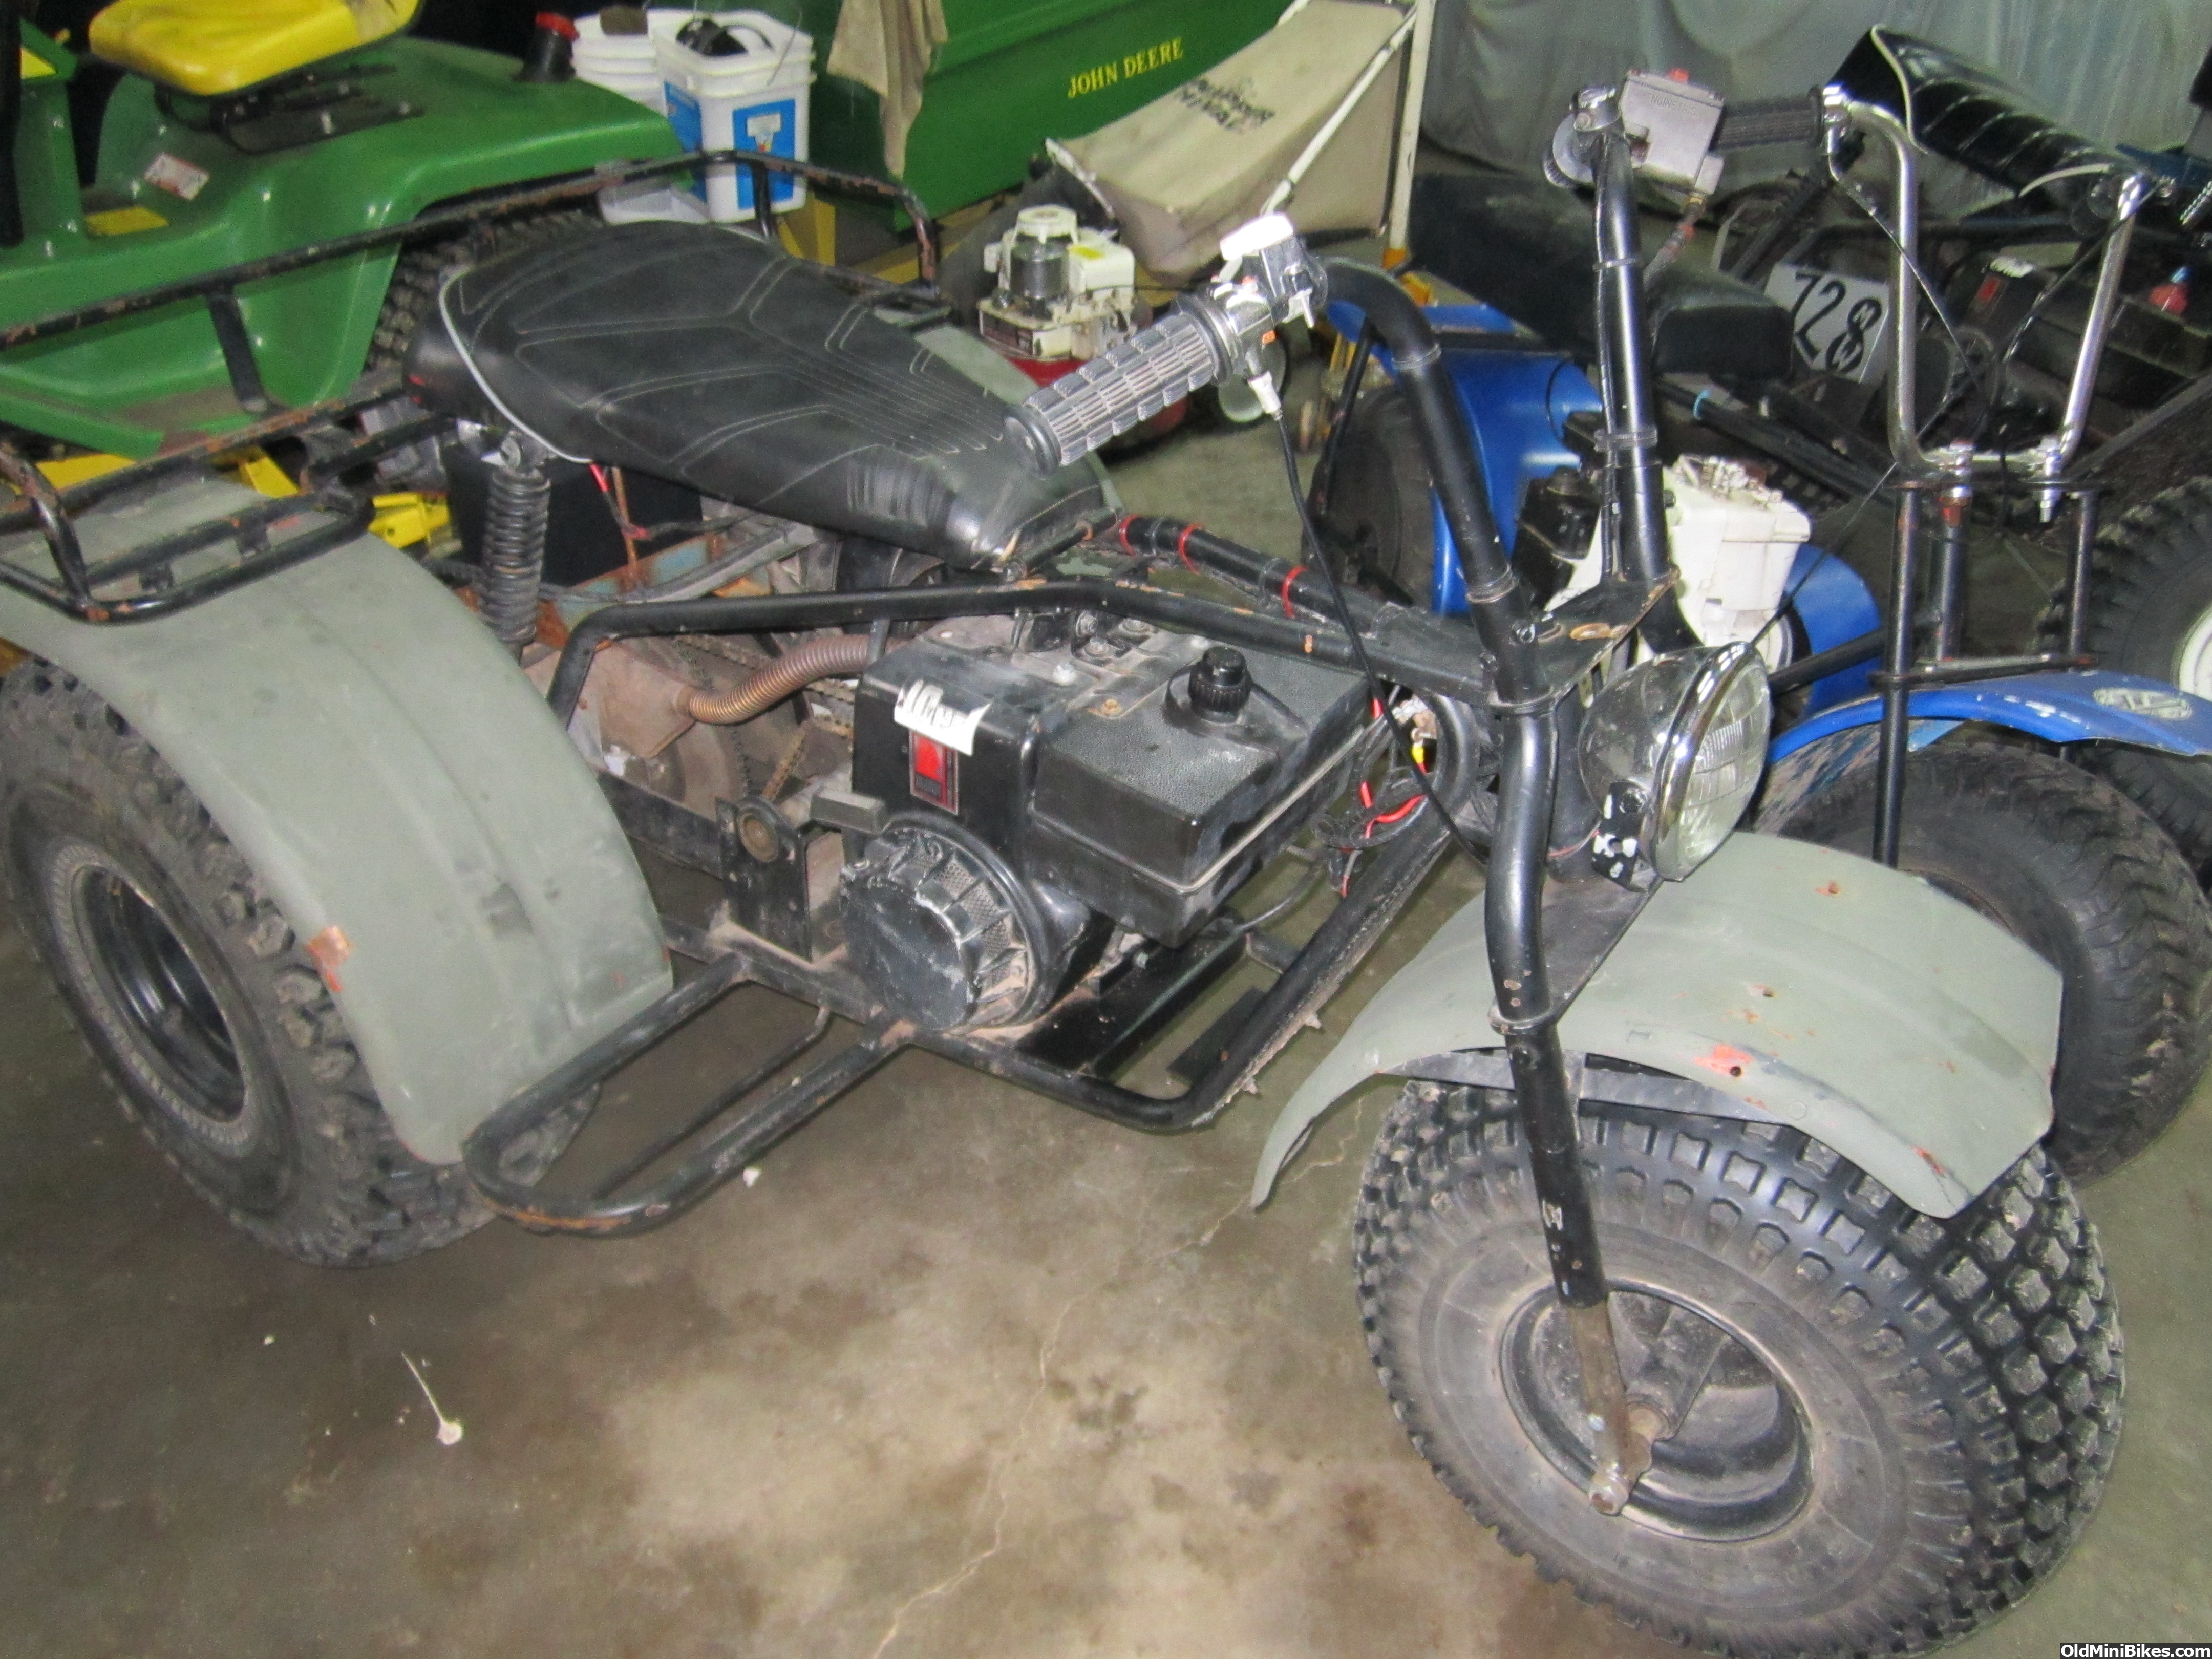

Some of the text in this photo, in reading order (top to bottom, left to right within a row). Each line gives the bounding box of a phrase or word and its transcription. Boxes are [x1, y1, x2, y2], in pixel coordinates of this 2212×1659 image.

[1068, 36, 1184, 98] JOHN DEERE
[1792, 270, 1883, 374] 728
